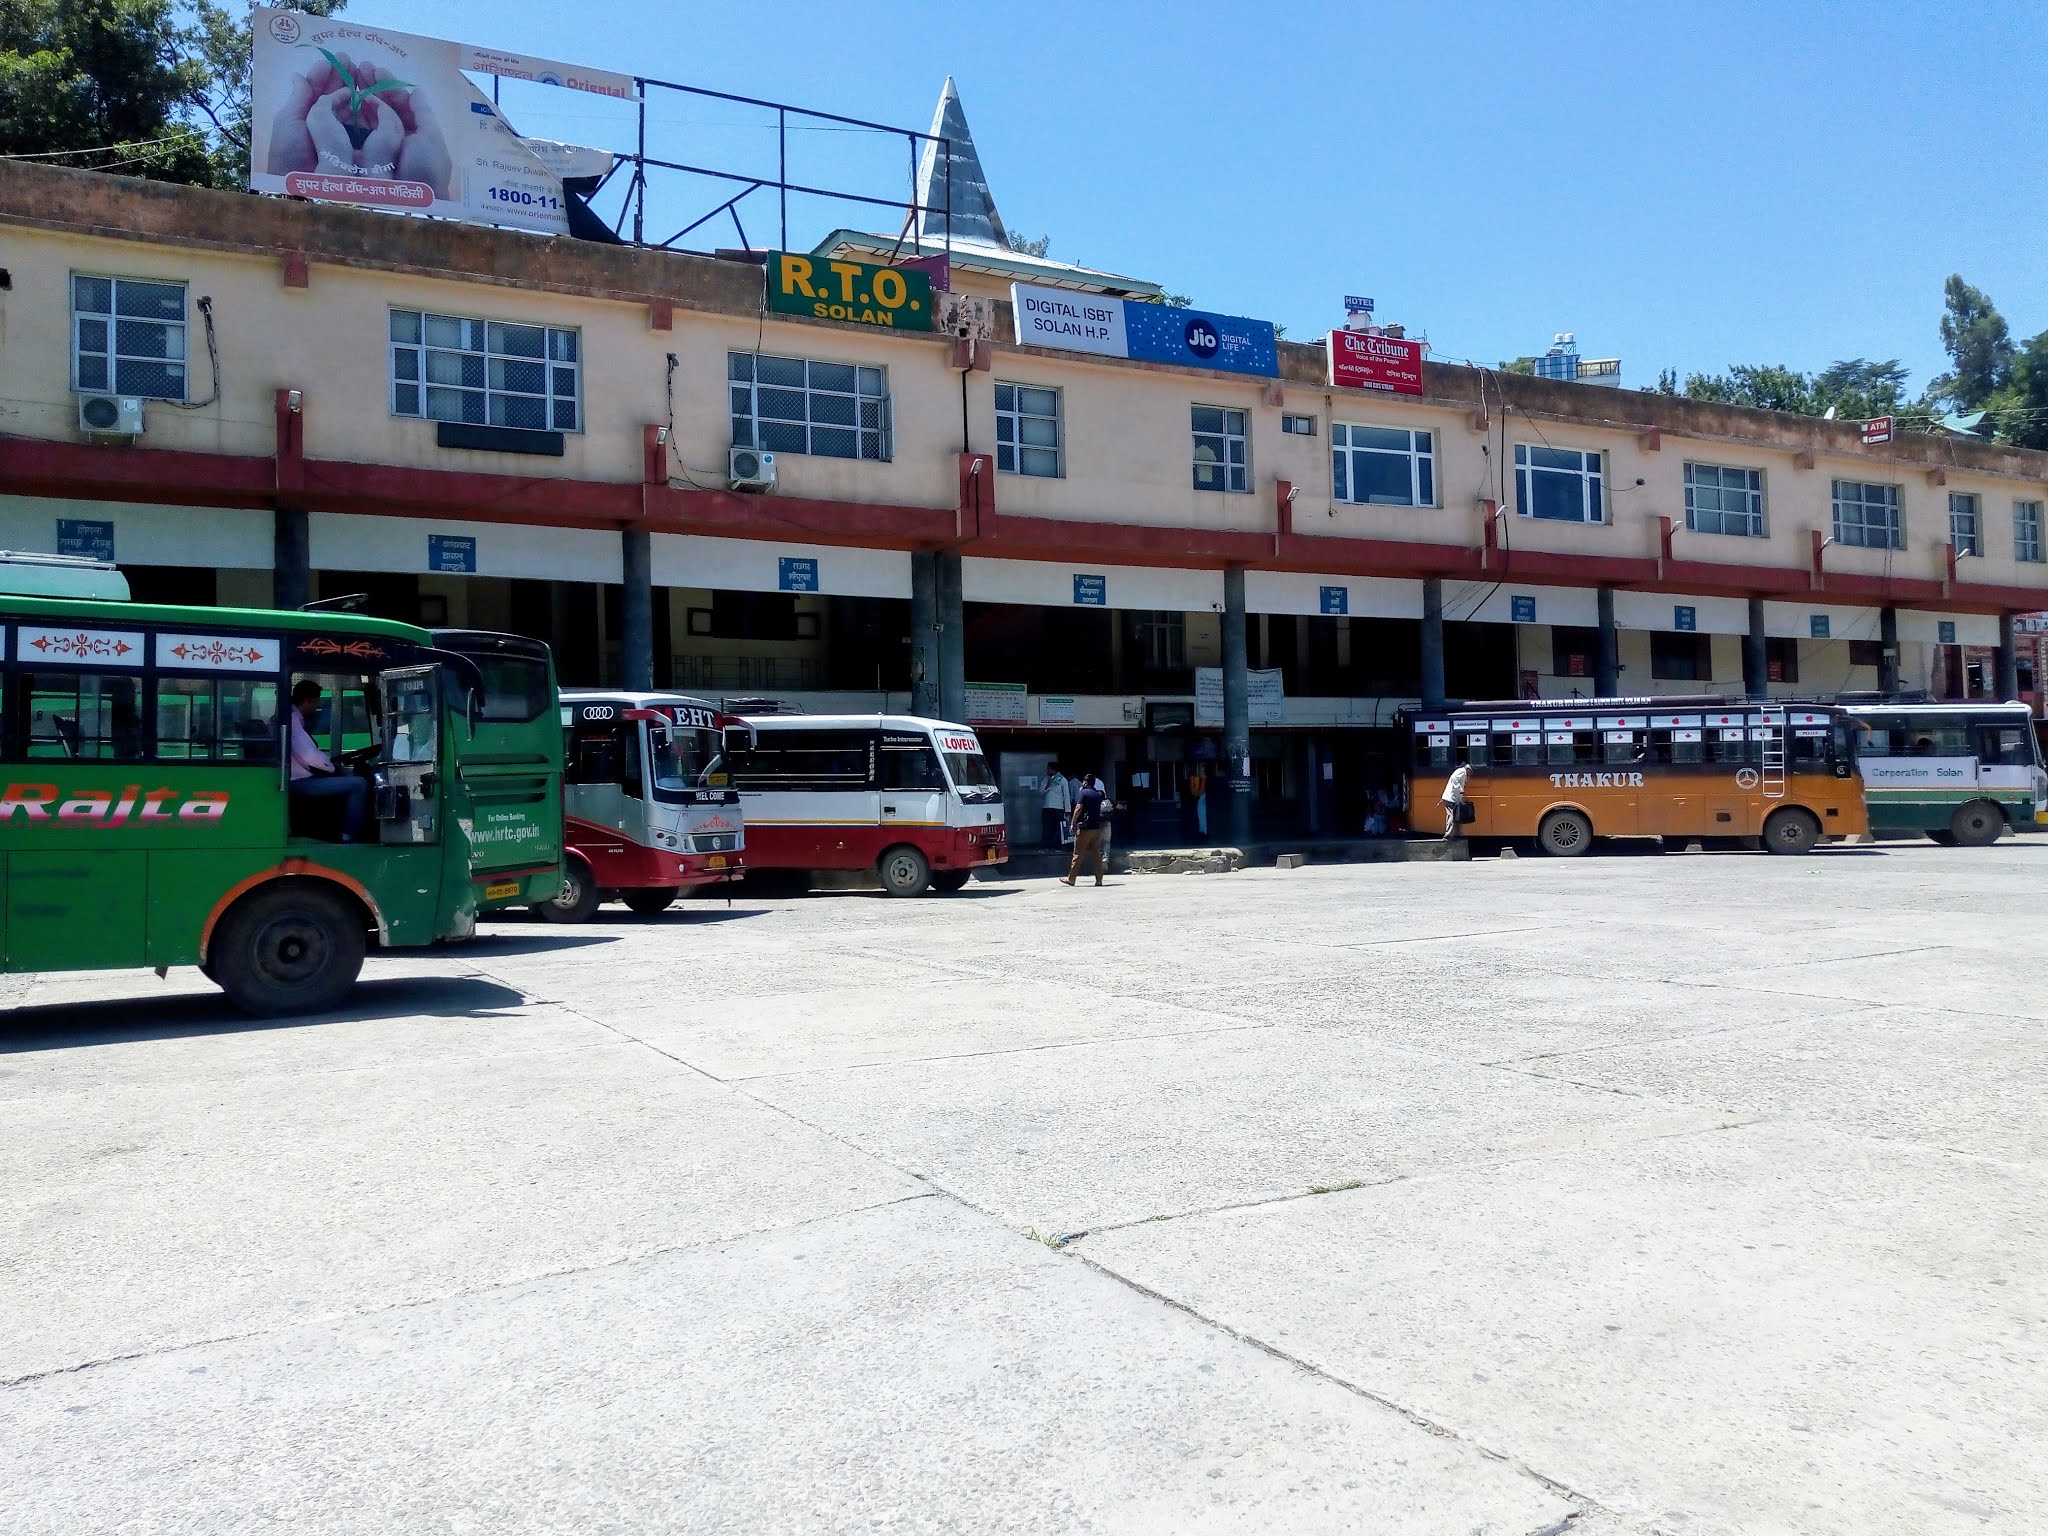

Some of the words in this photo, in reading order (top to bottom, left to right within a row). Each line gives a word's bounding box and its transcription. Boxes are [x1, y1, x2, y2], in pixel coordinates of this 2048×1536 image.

[566, 77, 626, 98] Oriental
[295, 178, 320, 194] सुपर
[389, 184, 424, 199] पॉलिसी
[506, 207, 569, 223] www.orientalin
[780, 254, 921, 312] R.T.O.
[1345, 296, 1374, 306] HOTEL
[813, 302, 894, 326] SOLAN
[1026, 298, 1080, 319] DIGITAL
[1082, 307, 1114, 323] ISBT
[1033, 317, 1082, 337] SOLAN
[1085, 326, 1110, 341] H.P.
[1188, 327, 1217, 349] Jio
[1221, 333, 1252, 346] DIGITAL
[1344, 334, 1366, 352] The
[1367, 338, 1409, 358] Tribune
[1221, 342, 1240, 352] LIFE
[1355, 353, 1369, 361] Voice
[1870, 421, 1887, 431] ATM
[431, 536, 437, 544] 2
[674, 707, 715, 728] EHT
[882, 735, 897, 743] Turbo
[944, 737, 976, 751] LOVELY
[1549, 771, 1644, 789] THAKUR
[1872, 768, 1928, 779] Corporation
[1936, 768, 1964, 777] Solan
[488, 814, 496, 822] For
[496, 813, 509, 822] Online
[470, 823, 540, 843] www.hrtc.gov.in
